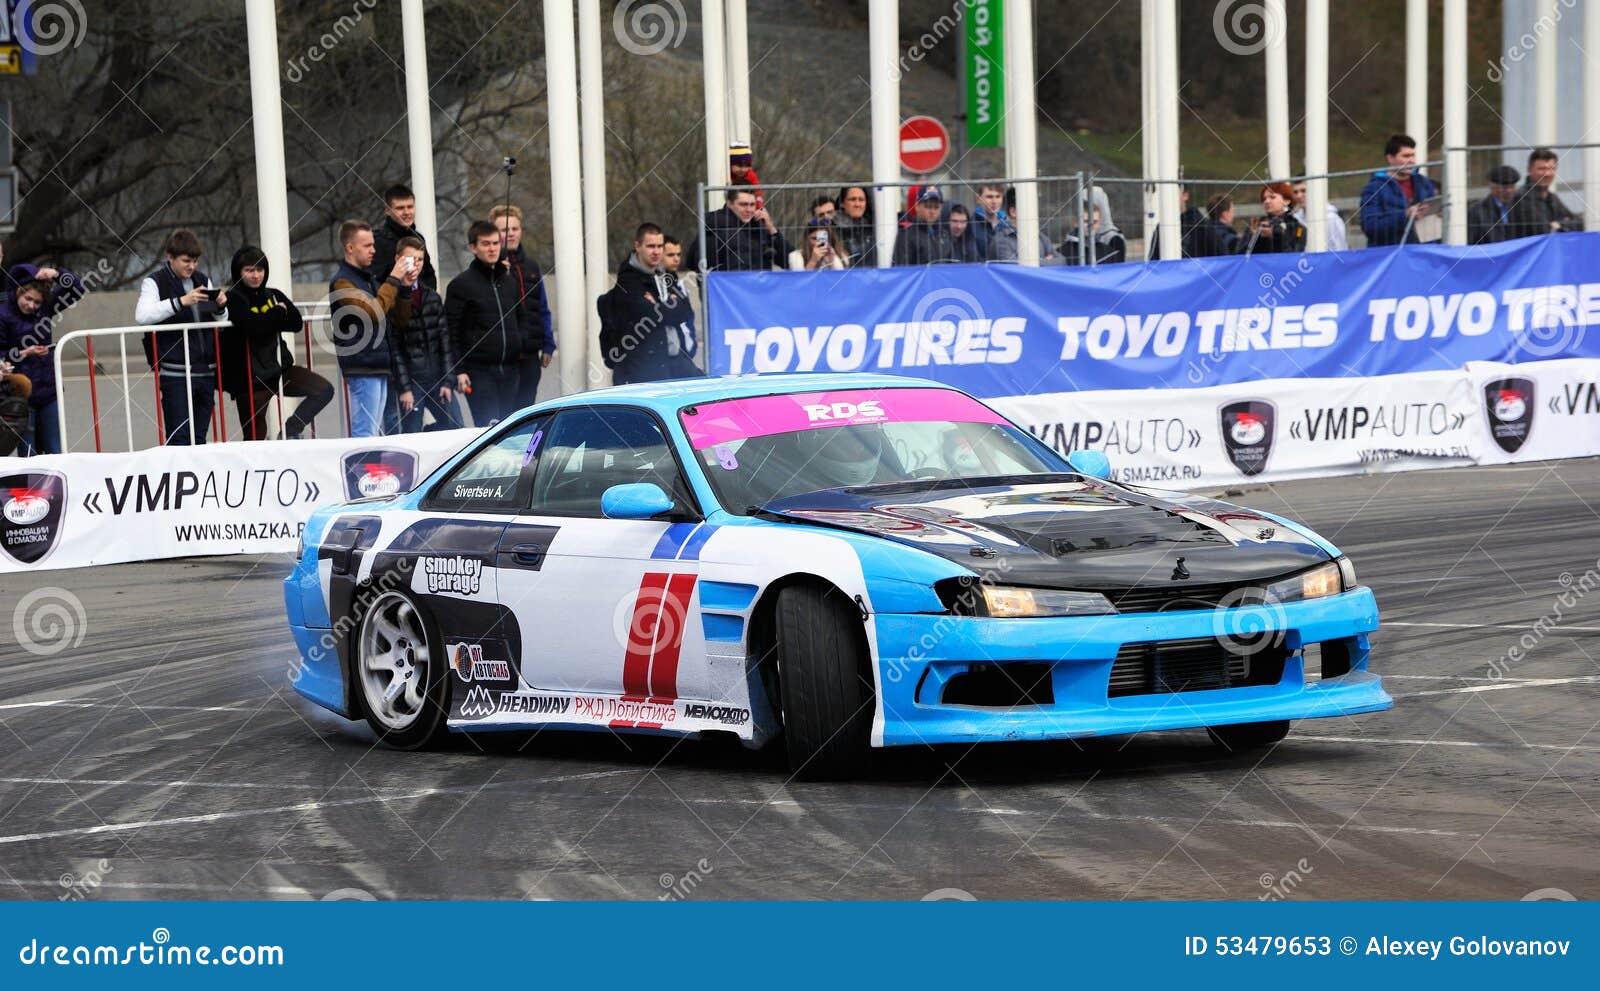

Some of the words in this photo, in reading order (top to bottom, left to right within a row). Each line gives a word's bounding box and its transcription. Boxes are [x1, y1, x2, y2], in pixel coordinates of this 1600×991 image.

[1368, 291, 1497, 342] TOYO
[1058, 311, 1190, 361] TOYO
[1195, 302, 1338, 354] TIRES
[724, 324, 868, 375] TOYO
[873, 316, 1027, 368] TIRES
[802, 400, 885, 421] RDS
[454, 485, 493, 498] Sivertsev
[425, 555, 482, 577] smokey
[428, 573, 480, 594] garage
[498, 695, 570, 714] HEADWAY
[575, 696, 604, 720] РЖД
[607, 699, 677, 722] Логистика
